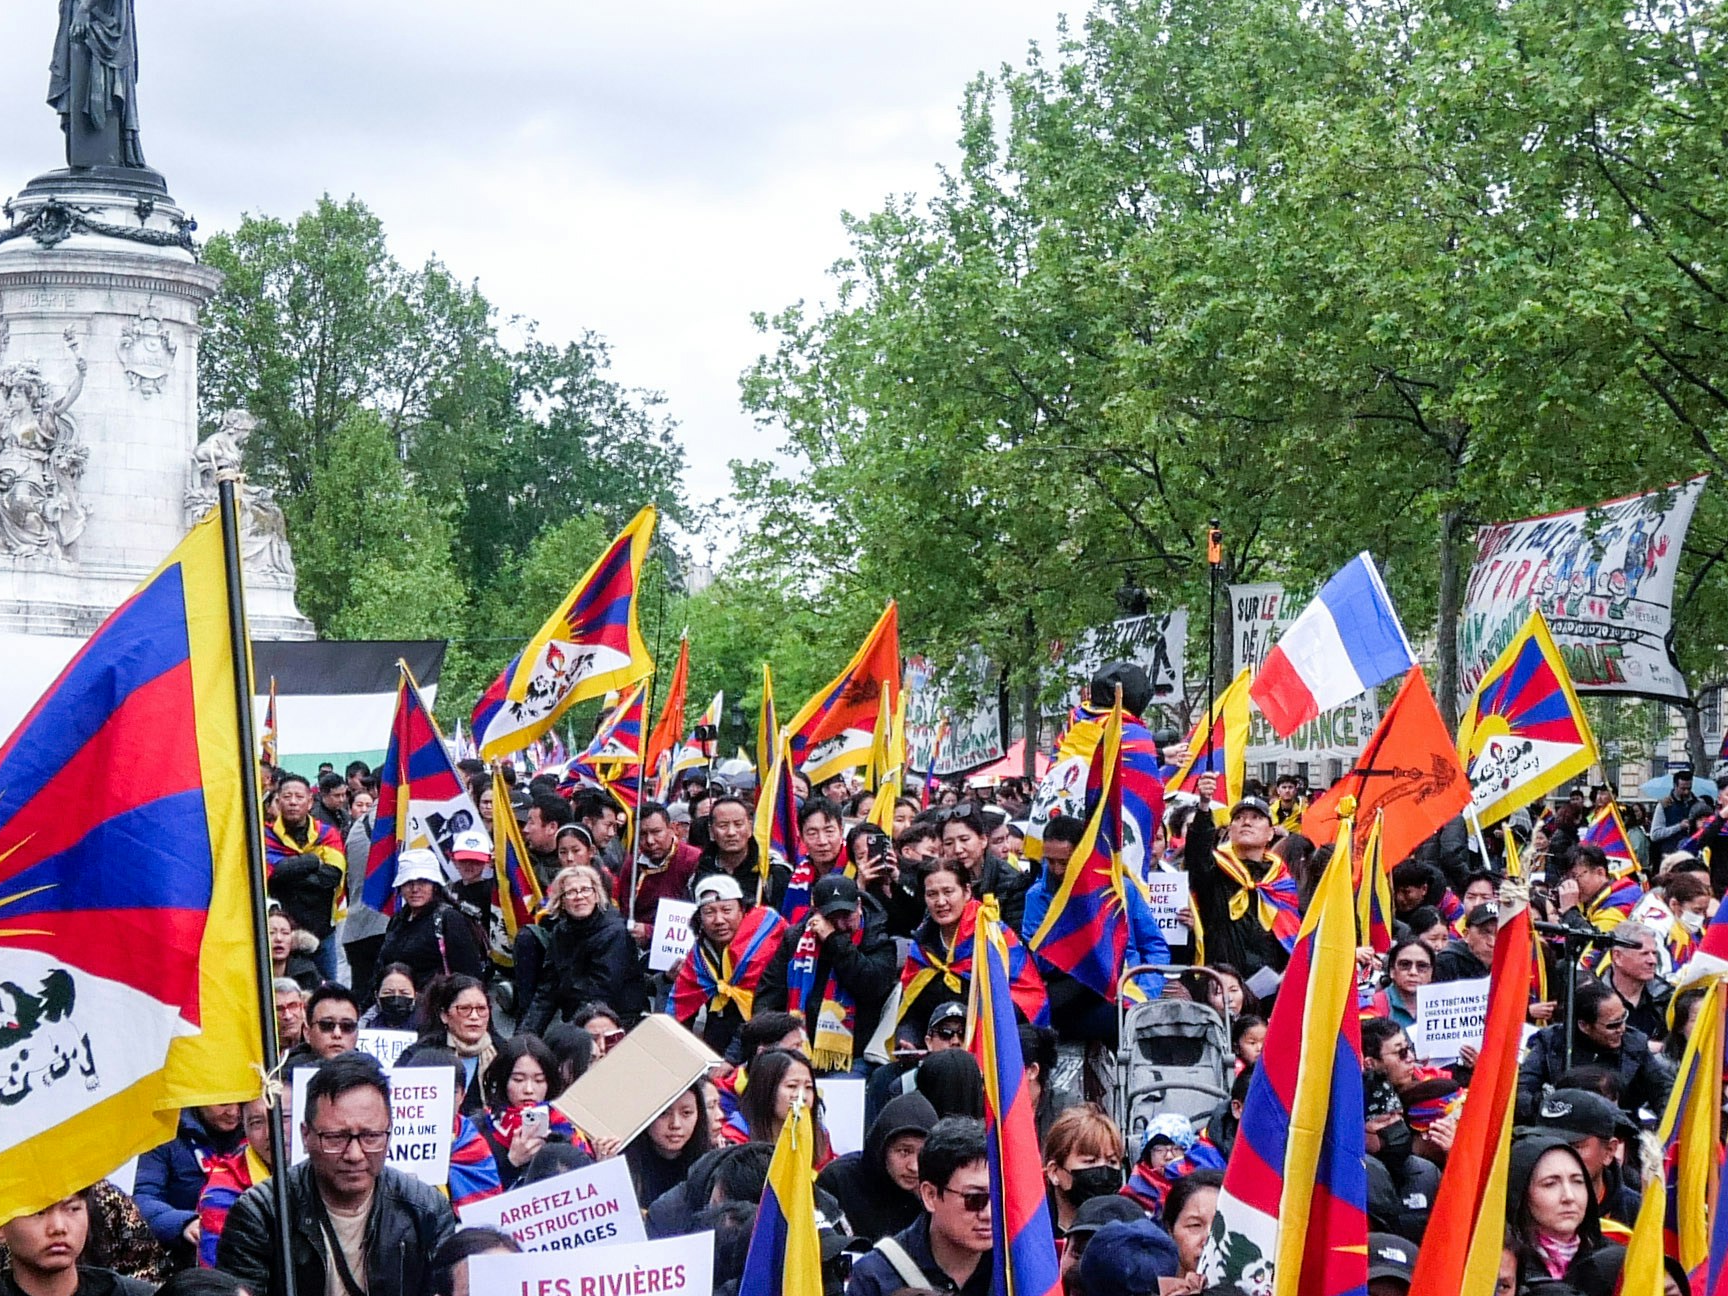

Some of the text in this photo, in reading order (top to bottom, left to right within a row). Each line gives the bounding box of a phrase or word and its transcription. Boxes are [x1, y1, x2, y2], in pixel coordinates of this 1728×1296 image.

[1238, 597, 1258, 622] SUR
[1261, 596, 1278, 620] LE
[1149, 884, 1177, 892] ECTES
[1150, 895, 1169, 904] NCE
[665, 927, 687, 942] AU
[661, 945, 673, 953] UN
[1425, 1000, 1439, 1009] LES
[1441, 996, 1476, 1008] TIBÉTAINS
[1426, 1015, 1485, 1031] ET LE MON
[1425, 1029, 1484, 1042] REGARDE AILLE
[390, 1086, 438, 1101] ECTES
[391, 1105, 424, 1119] NCE
[393, 1123, 437, 1135] OI À UNE
[386, 1142, 437, 1162] ANCE!
[500, 1183, 598, 1227] ARRÊTEZ LA
[512, 1198, 619, 1244] NSTRUCTION
[528, 1222, 617, 1253] RRAGES
